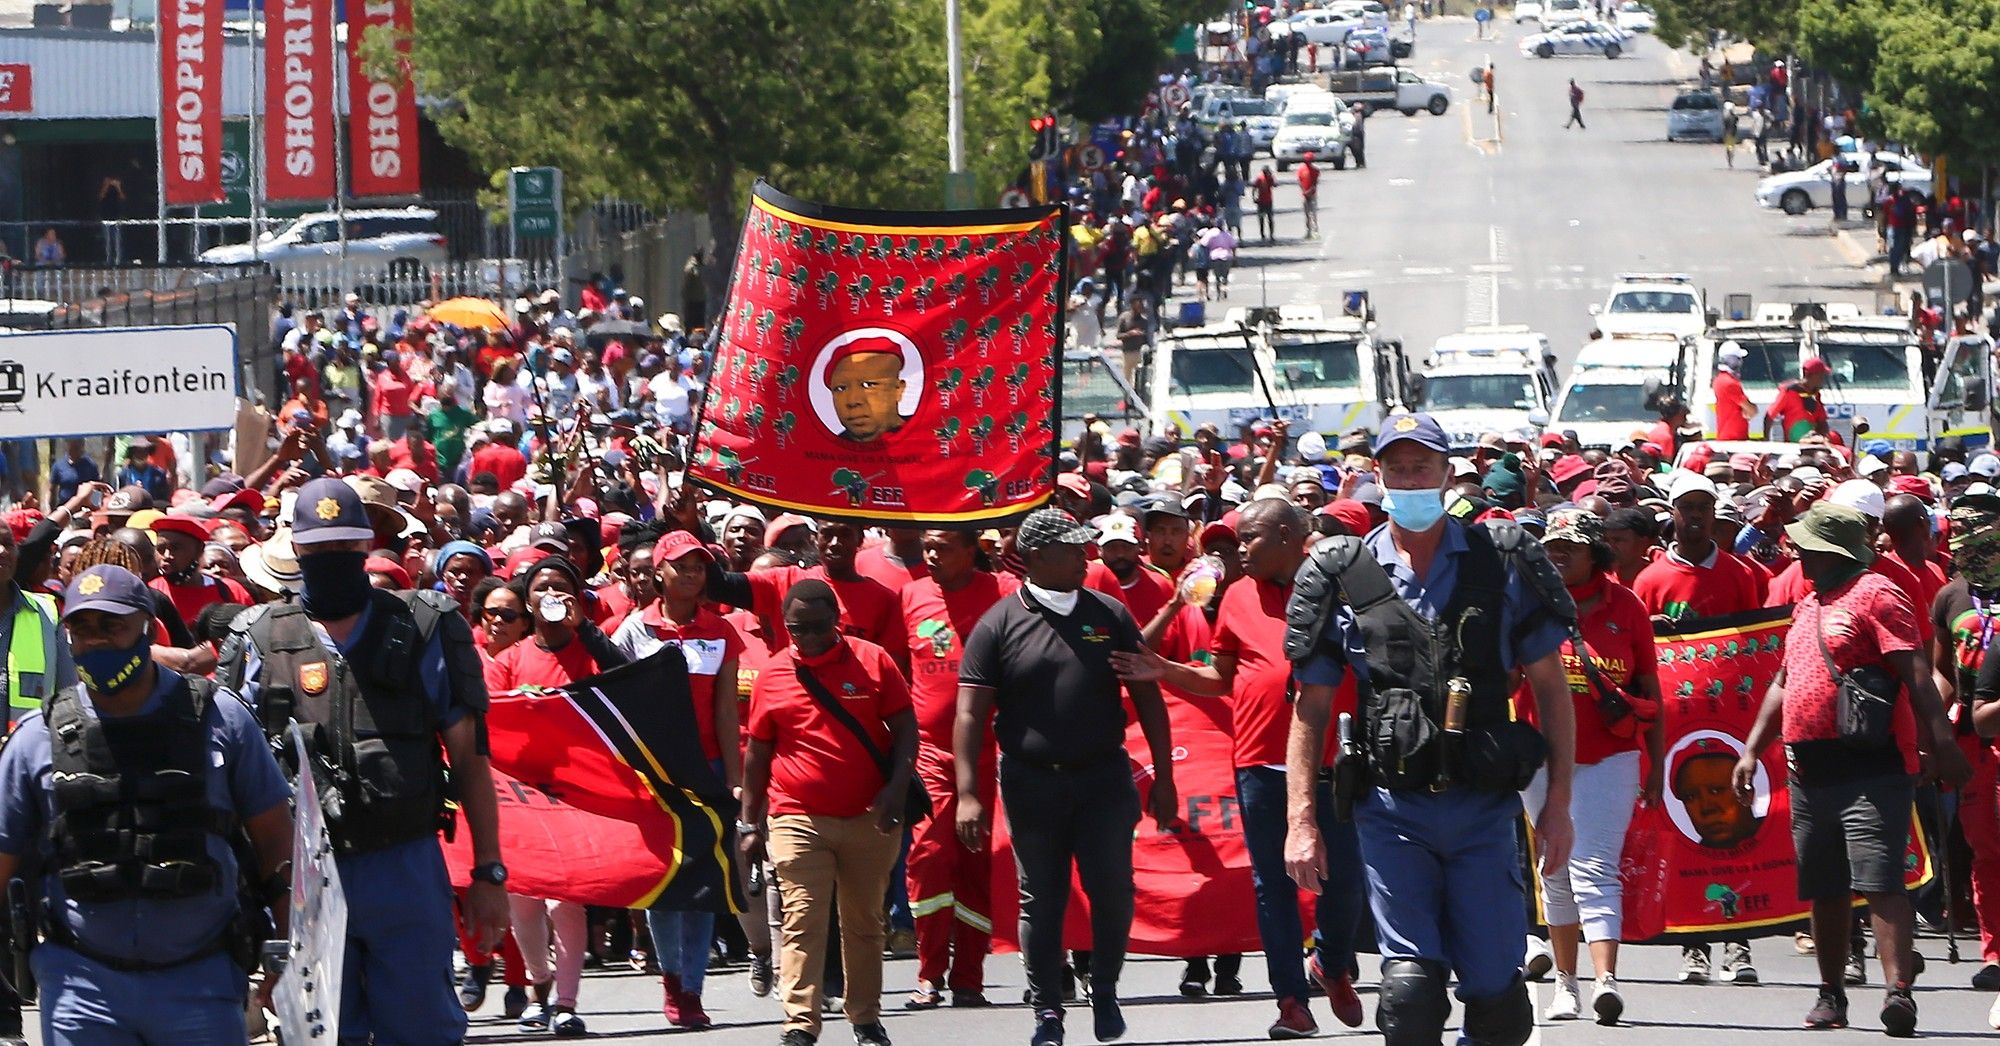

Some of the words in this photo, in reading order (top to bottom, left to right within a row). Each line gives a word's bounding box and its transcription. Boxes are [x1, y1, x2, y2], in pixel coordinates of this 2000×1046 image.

[283, 0, 315, 176] SHOPRI
[36, 365, 226, 398] Kraaifontein
[748, 471, 776, 488] EFF
[872, 486, 904, 502] EFF
[107, 655, 141, 689] SAPS
[1744, 894, 1769, 912] EFF
